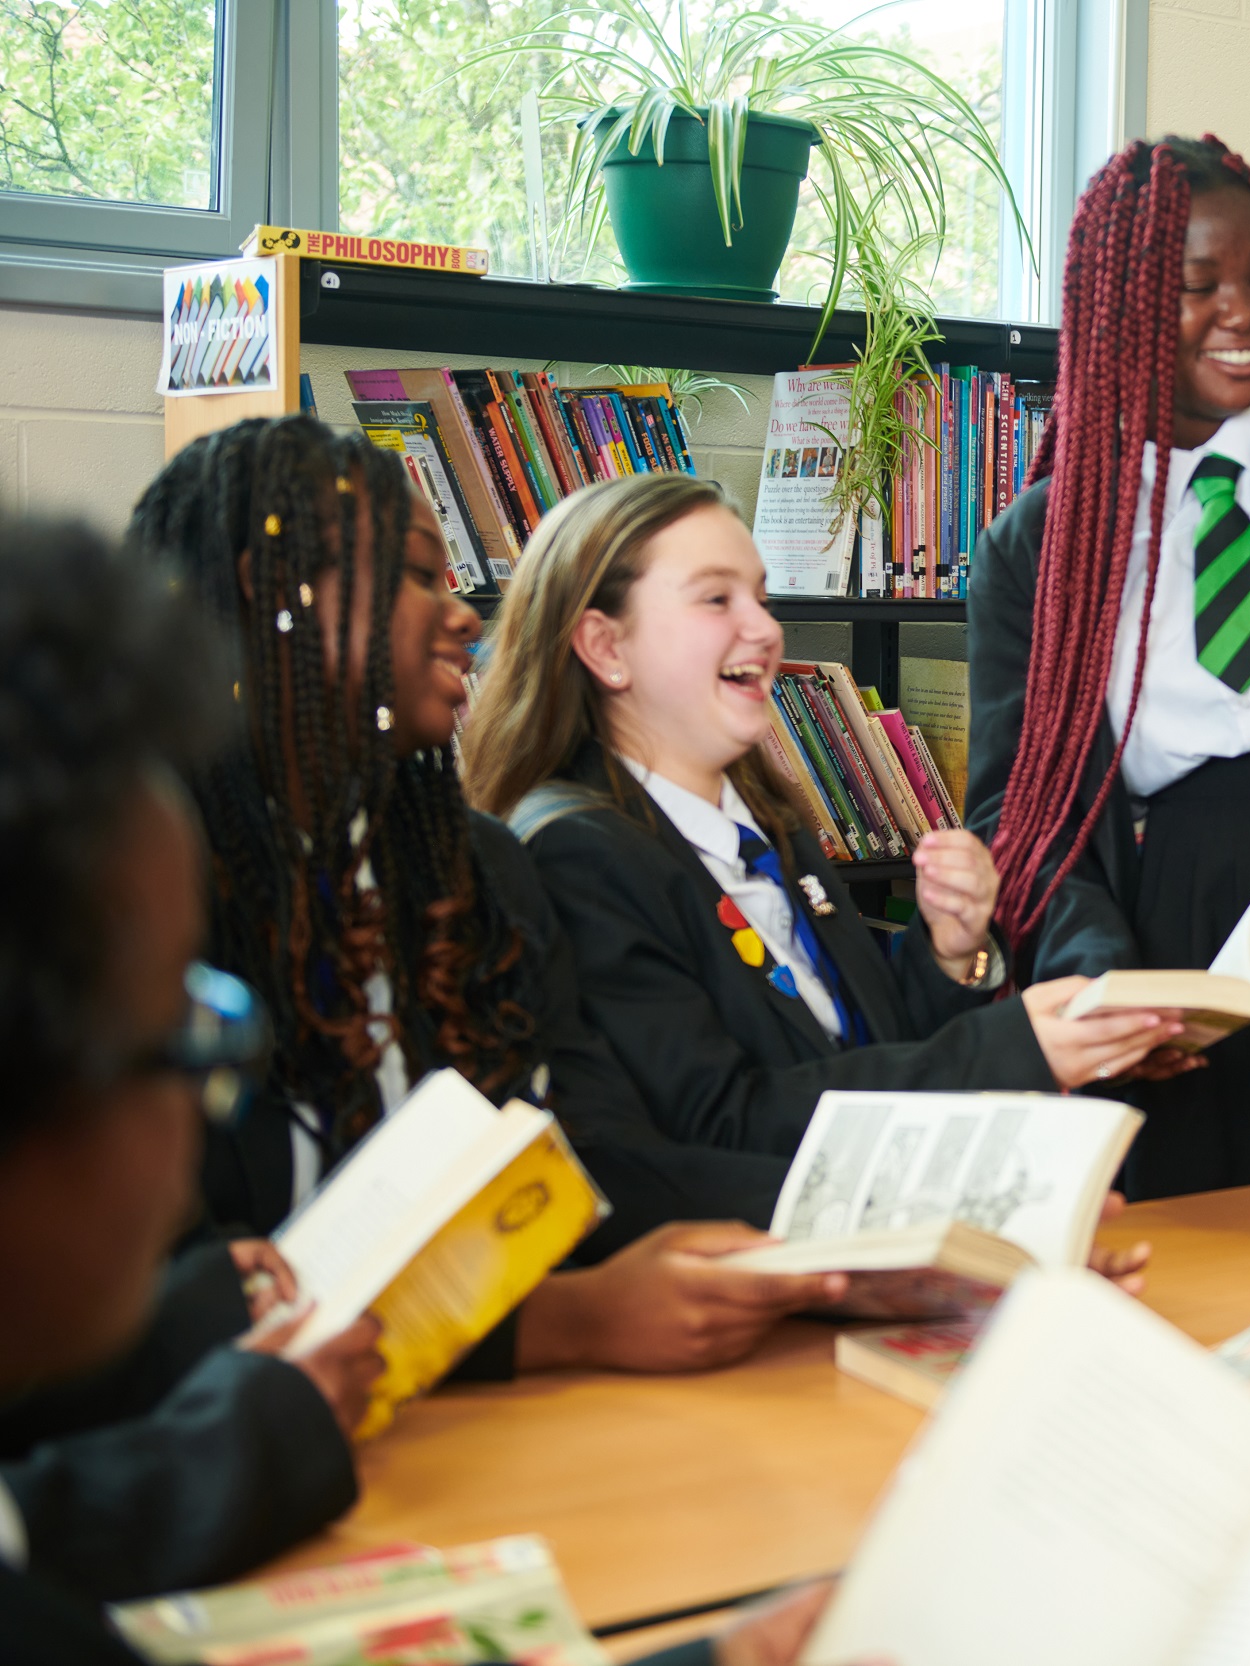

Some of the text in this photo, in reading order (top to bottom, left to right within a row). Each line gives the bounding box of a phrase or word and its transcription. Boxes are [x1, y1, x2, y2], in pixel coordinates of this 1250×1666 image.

[308, 233, 460, 269] THE PHILOSOPHY BOOK
[208, 315, 266, 341] FICTION
[787, 377, 821, 395] Why are
[774, 399, 790, 407] Where
[808, 396, 822, 406] world
[770, 415, 837, 432] Do we have free
[641, 432, 653, 455] FOOD
[660, 432, 669, 444] AN
[998, 414, 1008, 484] SCIENTIFIC
[486, 427, 517, 493] WATER SUPPLY
[764, 484, 779, 493] Puzzle
[803, 483, 828, 495] questions
[760, 516, 769, 524] This
[771, 515, 782, 524] book
[795, 515, 824, 524] entertaining
[898, 721, 907, 734] THIS
[906, 740, 915, 752] NOT
[913, 757, 923, 773] DRILL
[845, 736, 860, 763] MIGRATION
[863, 773, 877, 799] REFUGEES
[896, 766, 915, 803] COMING TO
